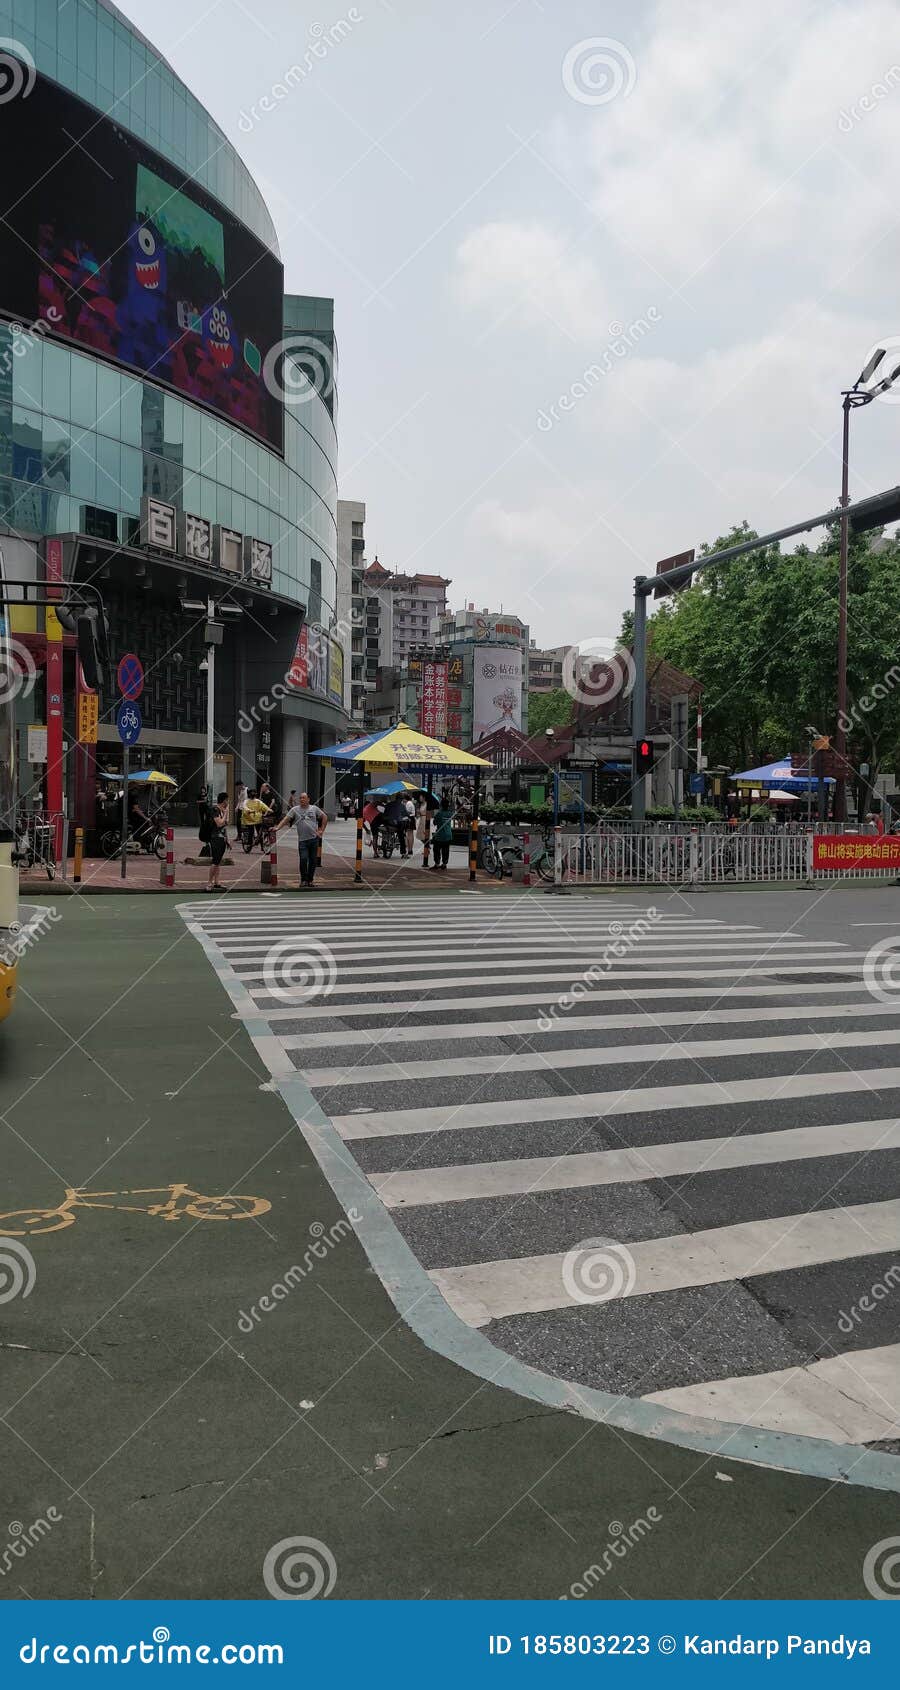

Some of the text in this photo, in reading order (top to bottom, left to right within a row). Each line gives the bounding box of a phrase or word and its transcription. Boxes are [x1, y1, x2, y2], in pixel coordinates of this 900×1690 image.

[149, 500, 271, 580] 百花广场
[818, 842, 900, 859] 佛山将实施电动自行
